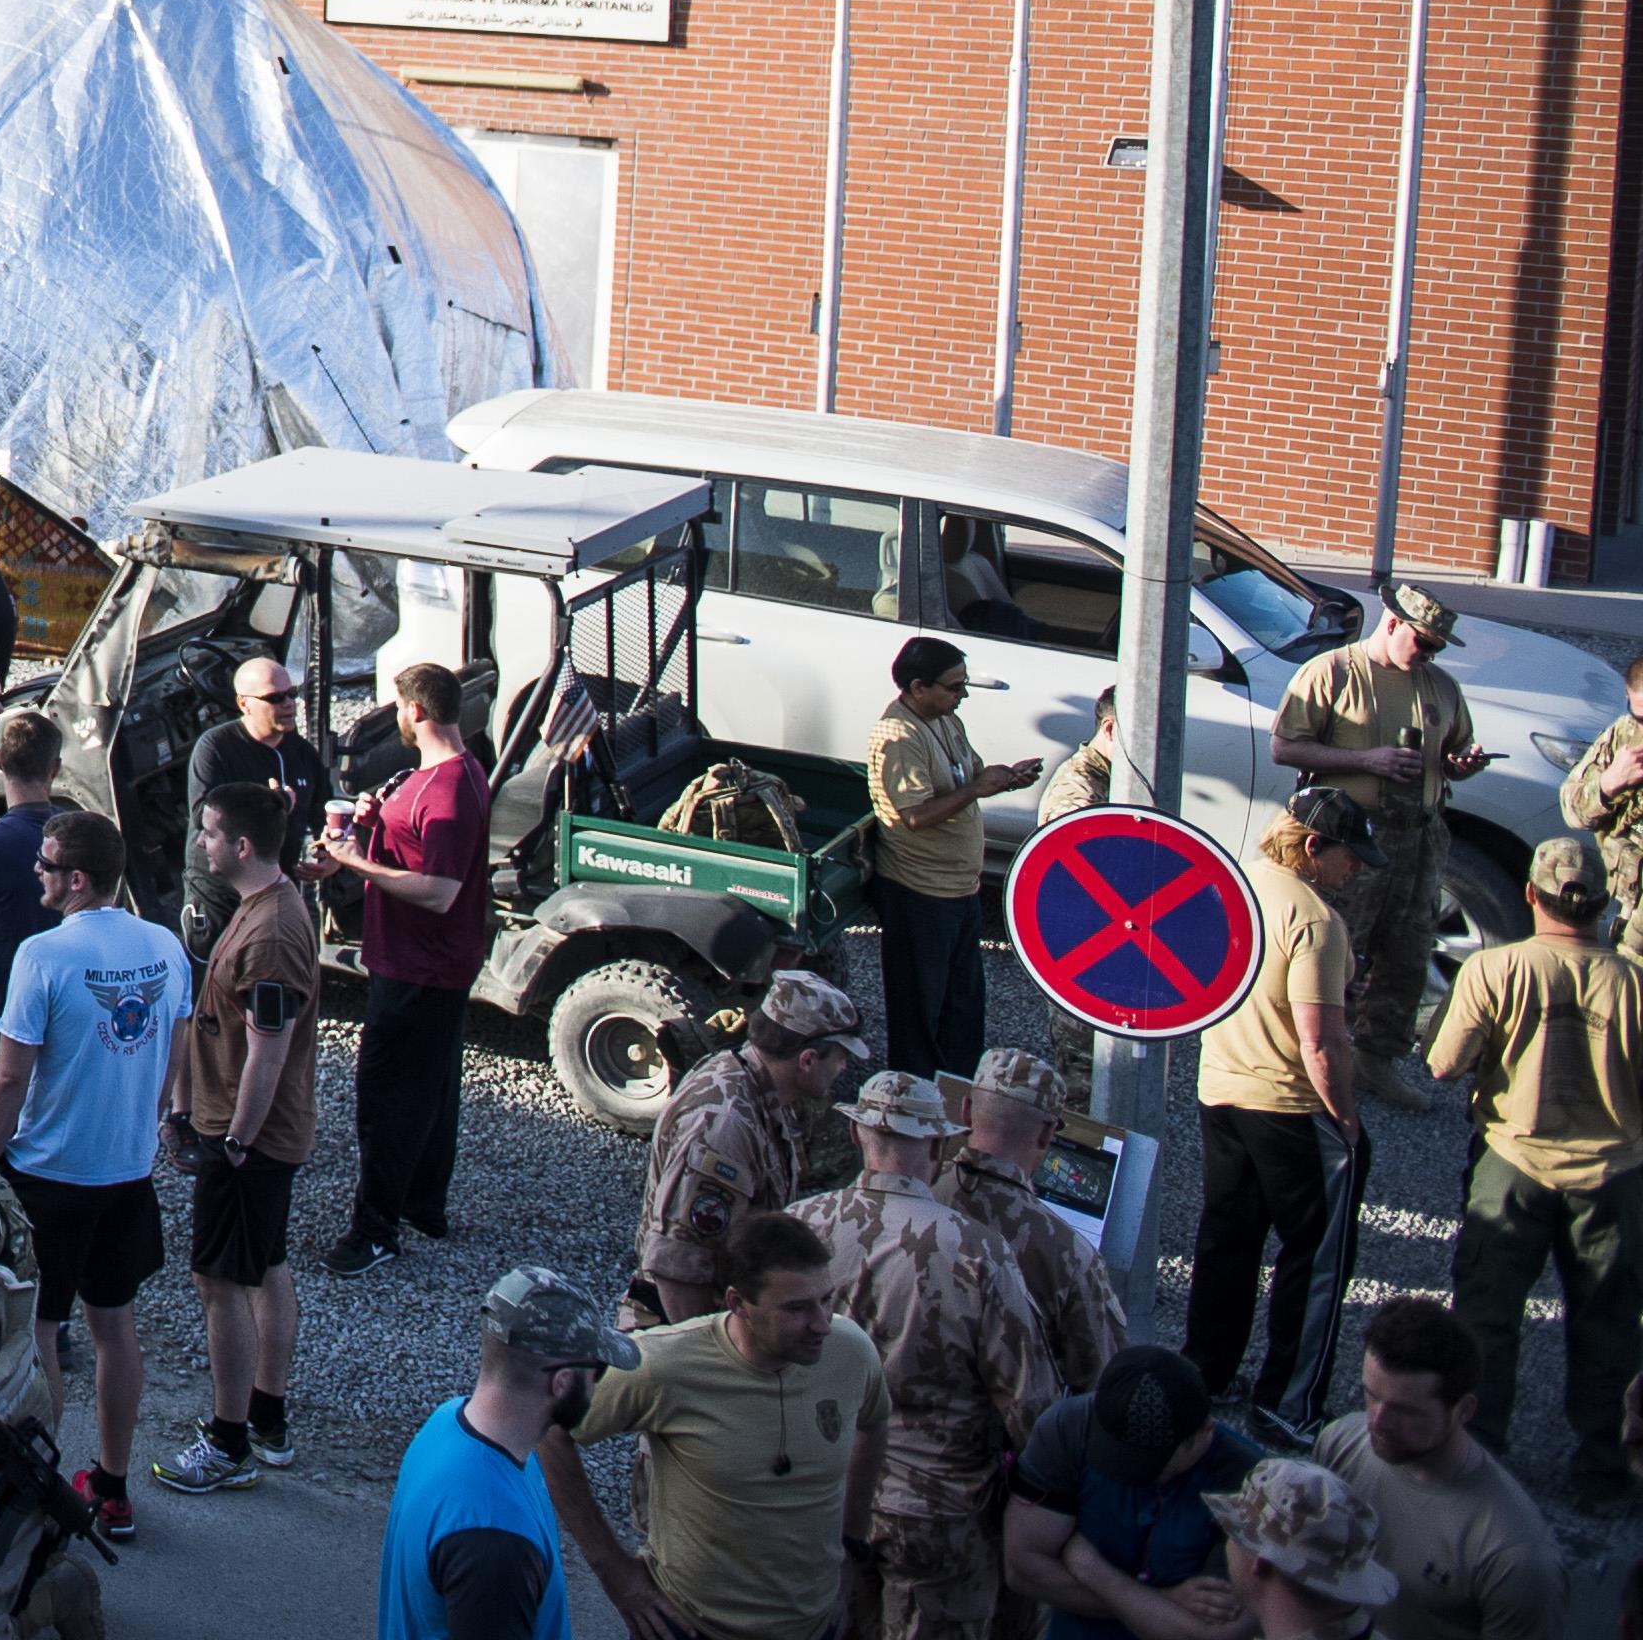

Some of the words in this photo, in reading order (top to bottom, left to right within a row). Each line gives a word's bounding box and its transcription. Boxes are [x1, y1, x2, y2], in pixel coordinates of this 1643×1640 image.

[578, 845, 692, 885] Kawasaki
[84, 968, 136, 983] MILITARY
[138, 959, 169, 979] TEAM
[97, 1021, 120, 1055] CZECH
[123, 1015, 160, 1056] REPUBLIC
